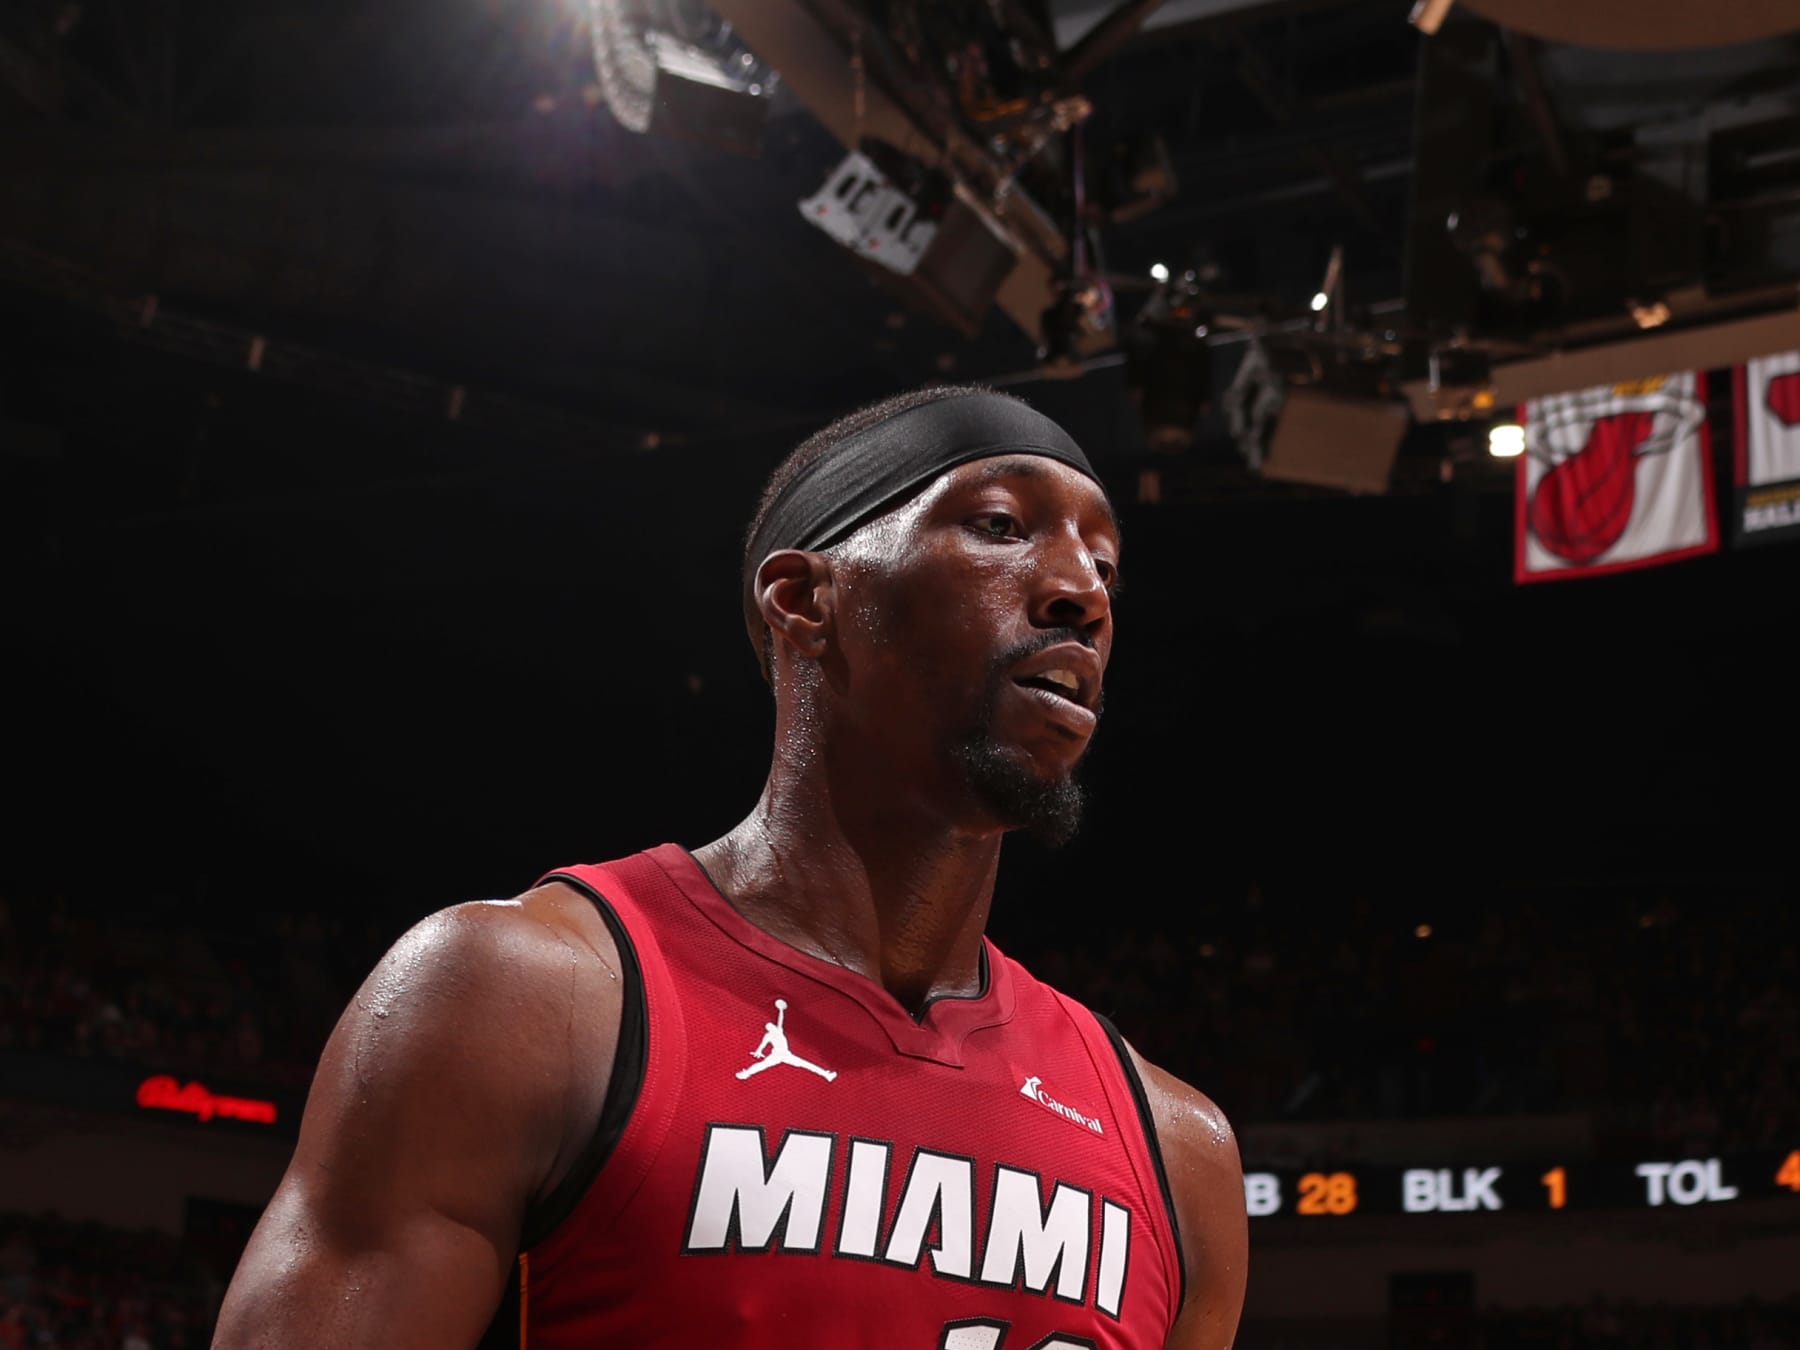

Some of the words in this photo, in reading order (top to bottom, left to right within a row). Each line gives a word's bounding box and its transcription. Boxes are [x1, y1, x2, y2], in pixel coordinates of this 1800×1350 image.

[1037, 1089, 1104, 1134] Carnival
[1296, 1171, 1358, 1215] 28
[1402, 1166, 1503, 1213] BLK
[1541, 1166, 1567, 1209] 1
[1635, 1157, 1740, 1207] TOL
[681, 1121, 1132, 1320] MIAMI
